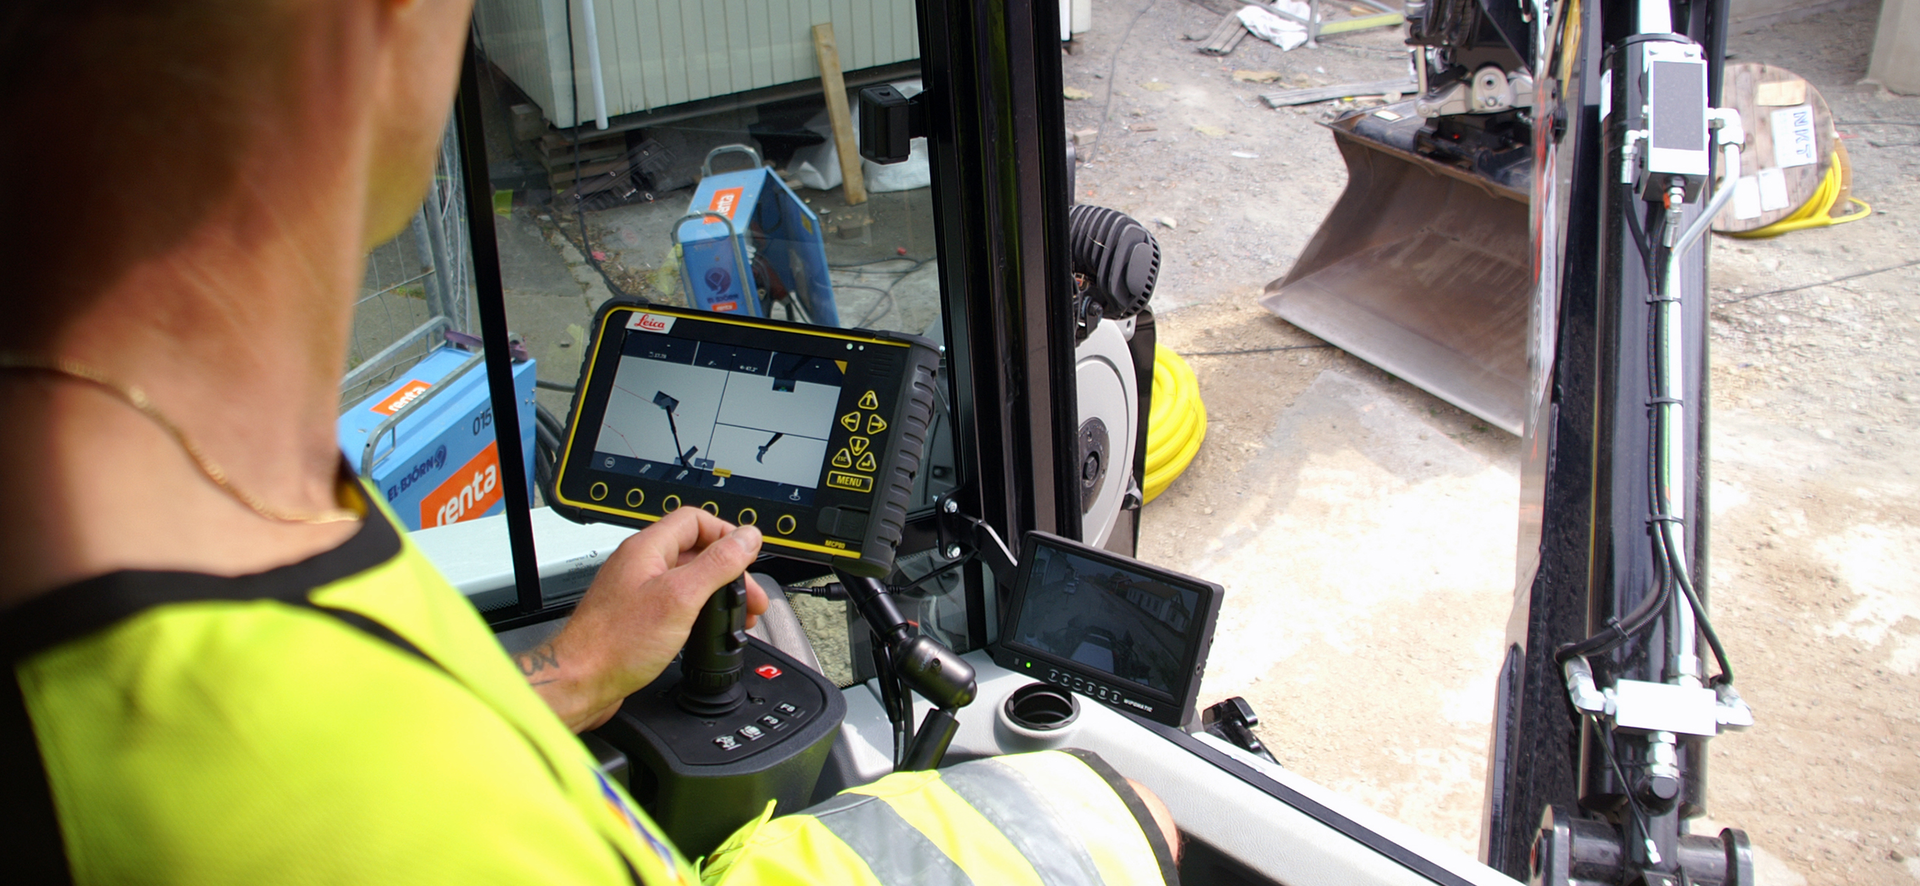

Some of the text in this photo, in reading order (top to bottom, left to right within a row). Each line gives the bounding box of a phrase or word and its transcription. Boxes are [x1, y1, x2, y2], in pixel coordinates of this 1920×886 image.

[634, 313, 666, 331] Leica
[388, 386, 426, 412] renta
[836, 475, 862, 488] MENU
[437, 464, 497, 528] renta
